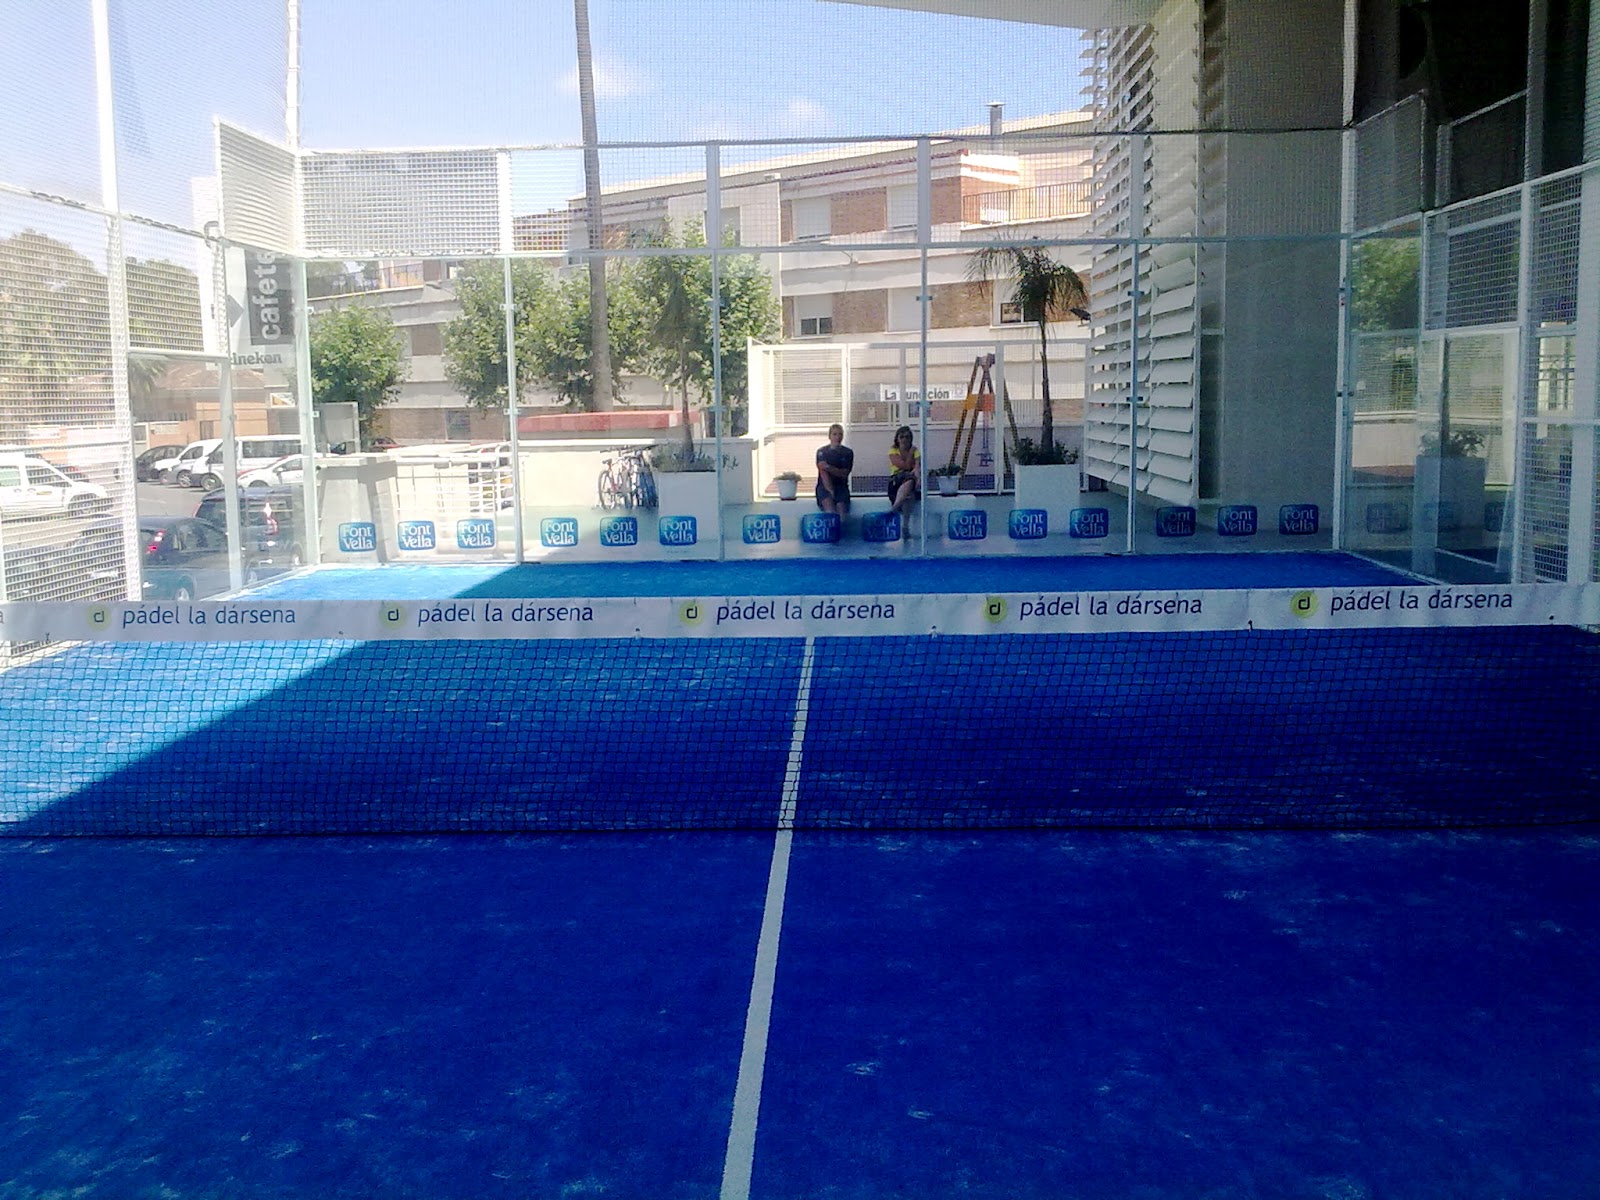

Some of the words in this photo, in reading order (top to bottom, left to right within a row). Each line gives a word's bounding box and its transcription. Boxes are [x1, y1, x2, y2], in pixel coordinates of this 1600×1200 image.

[230, 351, 283, 365] ineken
[884, 389, 897, 400] La
[901, 388, 950, 399] unción
[1013, 512, 1043, 524] Font
[1223, 508, 1253, 520] Font
[1284, 508, 1315, 520] Font
[342, 526, 372, 537] Font
[401, 525, 431, 536] Font
[460, 522, 490, 535] Font
[663, 519, 693, 531] Font
[953, 523, 983, 537] Vella
[1013, 522, 1043, 536] Vella
[1075, 521, 1105, 535] Vella
[1160, 520, 1192, 534] Vella
[1222, 518, 1253, 533] Vella
[1284, 518, 1315, 532] Vella
[402, 534, 433, 548] Vella
[461, 533, 492, 547] Vella
[545, 530, 575, 545] Vella
[604, 530, 634, 544] Vella
[664, 529, 694, 543] Vella
[747, 527, 778, 541] Vella
[343, 535, 374, 549] Vella
[1020, 596, 1080, 620] pádel
[1089, 597, 1108, 615] la
[1116, 592, 1202, 614] dársena
[1330, 590, 1390, 616] pádel
[1399, 590, 1419, 609] la
[1428, 588, 1513, 608] dársena
[122, 605, 180, 629] pádel
[189, 606, 206, 623] la
[215, 606, 296, 624] dársena
[418, 602, 476, 627] pádel
[485, 603, 503, 622] la
[511, 602, 594, 621] dársena
[716, 600, 775, 625] pádel
[784, 603, 802, 619] la
[811, 599, 895, 619] dársena
